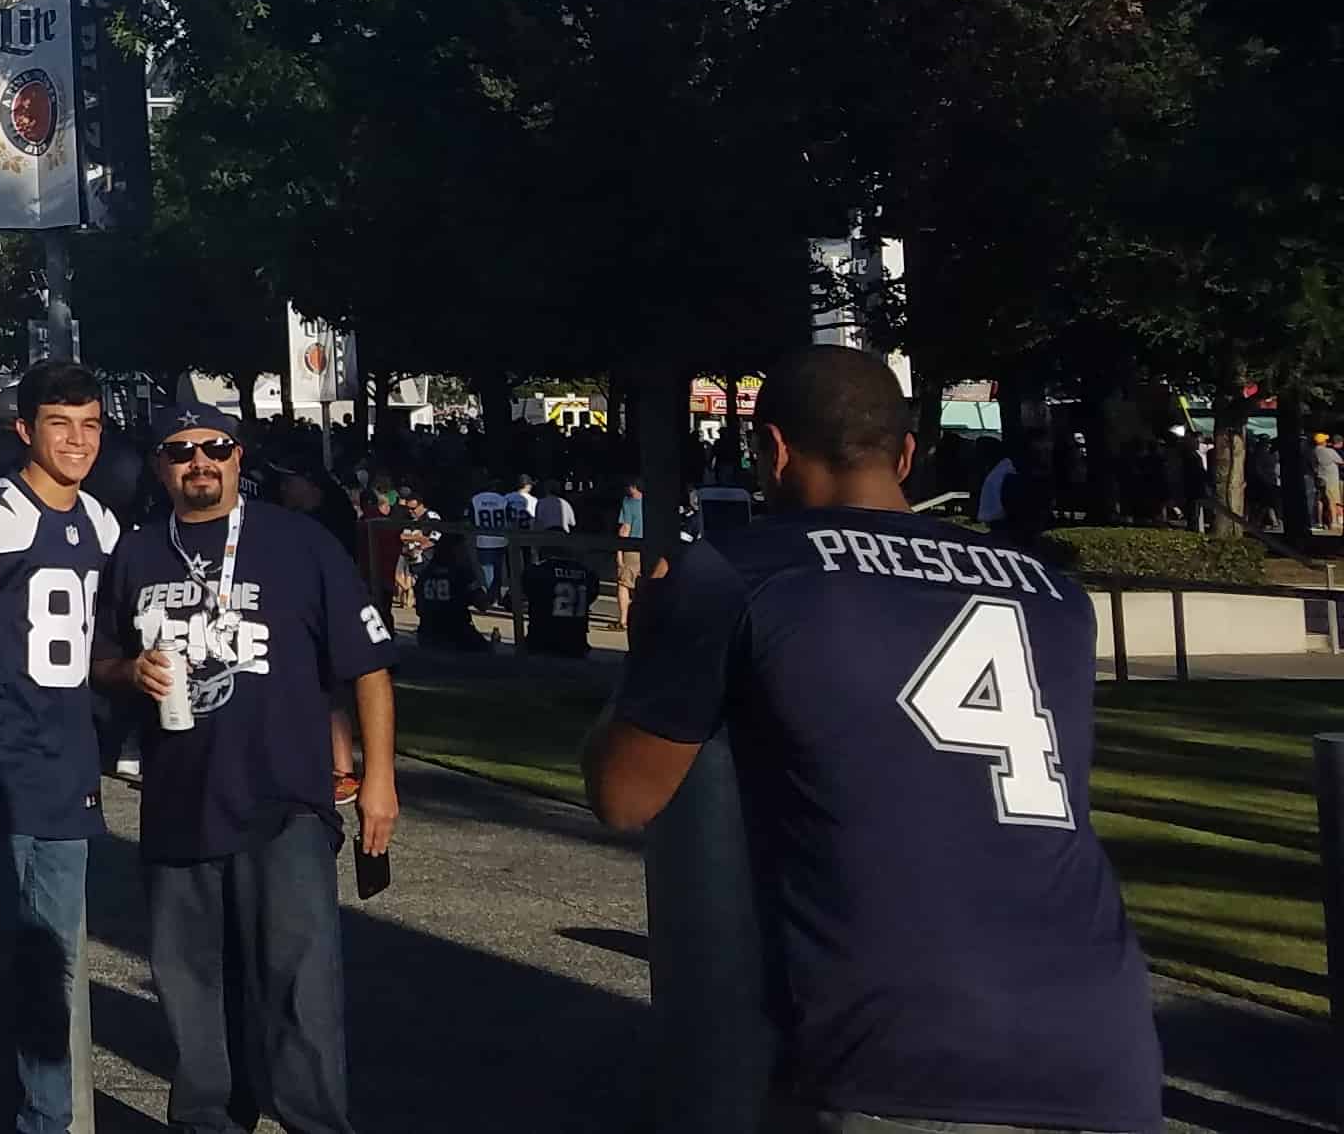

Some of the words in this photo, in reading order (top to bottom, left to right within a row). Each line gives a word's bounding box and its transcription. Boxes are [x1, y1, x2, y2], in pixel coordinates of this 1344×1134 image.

[138, 580, 202, 612] FEED
[552, 581, 588, 617] 21
[807, 529, 1063, 601] PRESCOTT
[28, 568, 100, 688] 8
[896, 594, 1076, 830] 4
